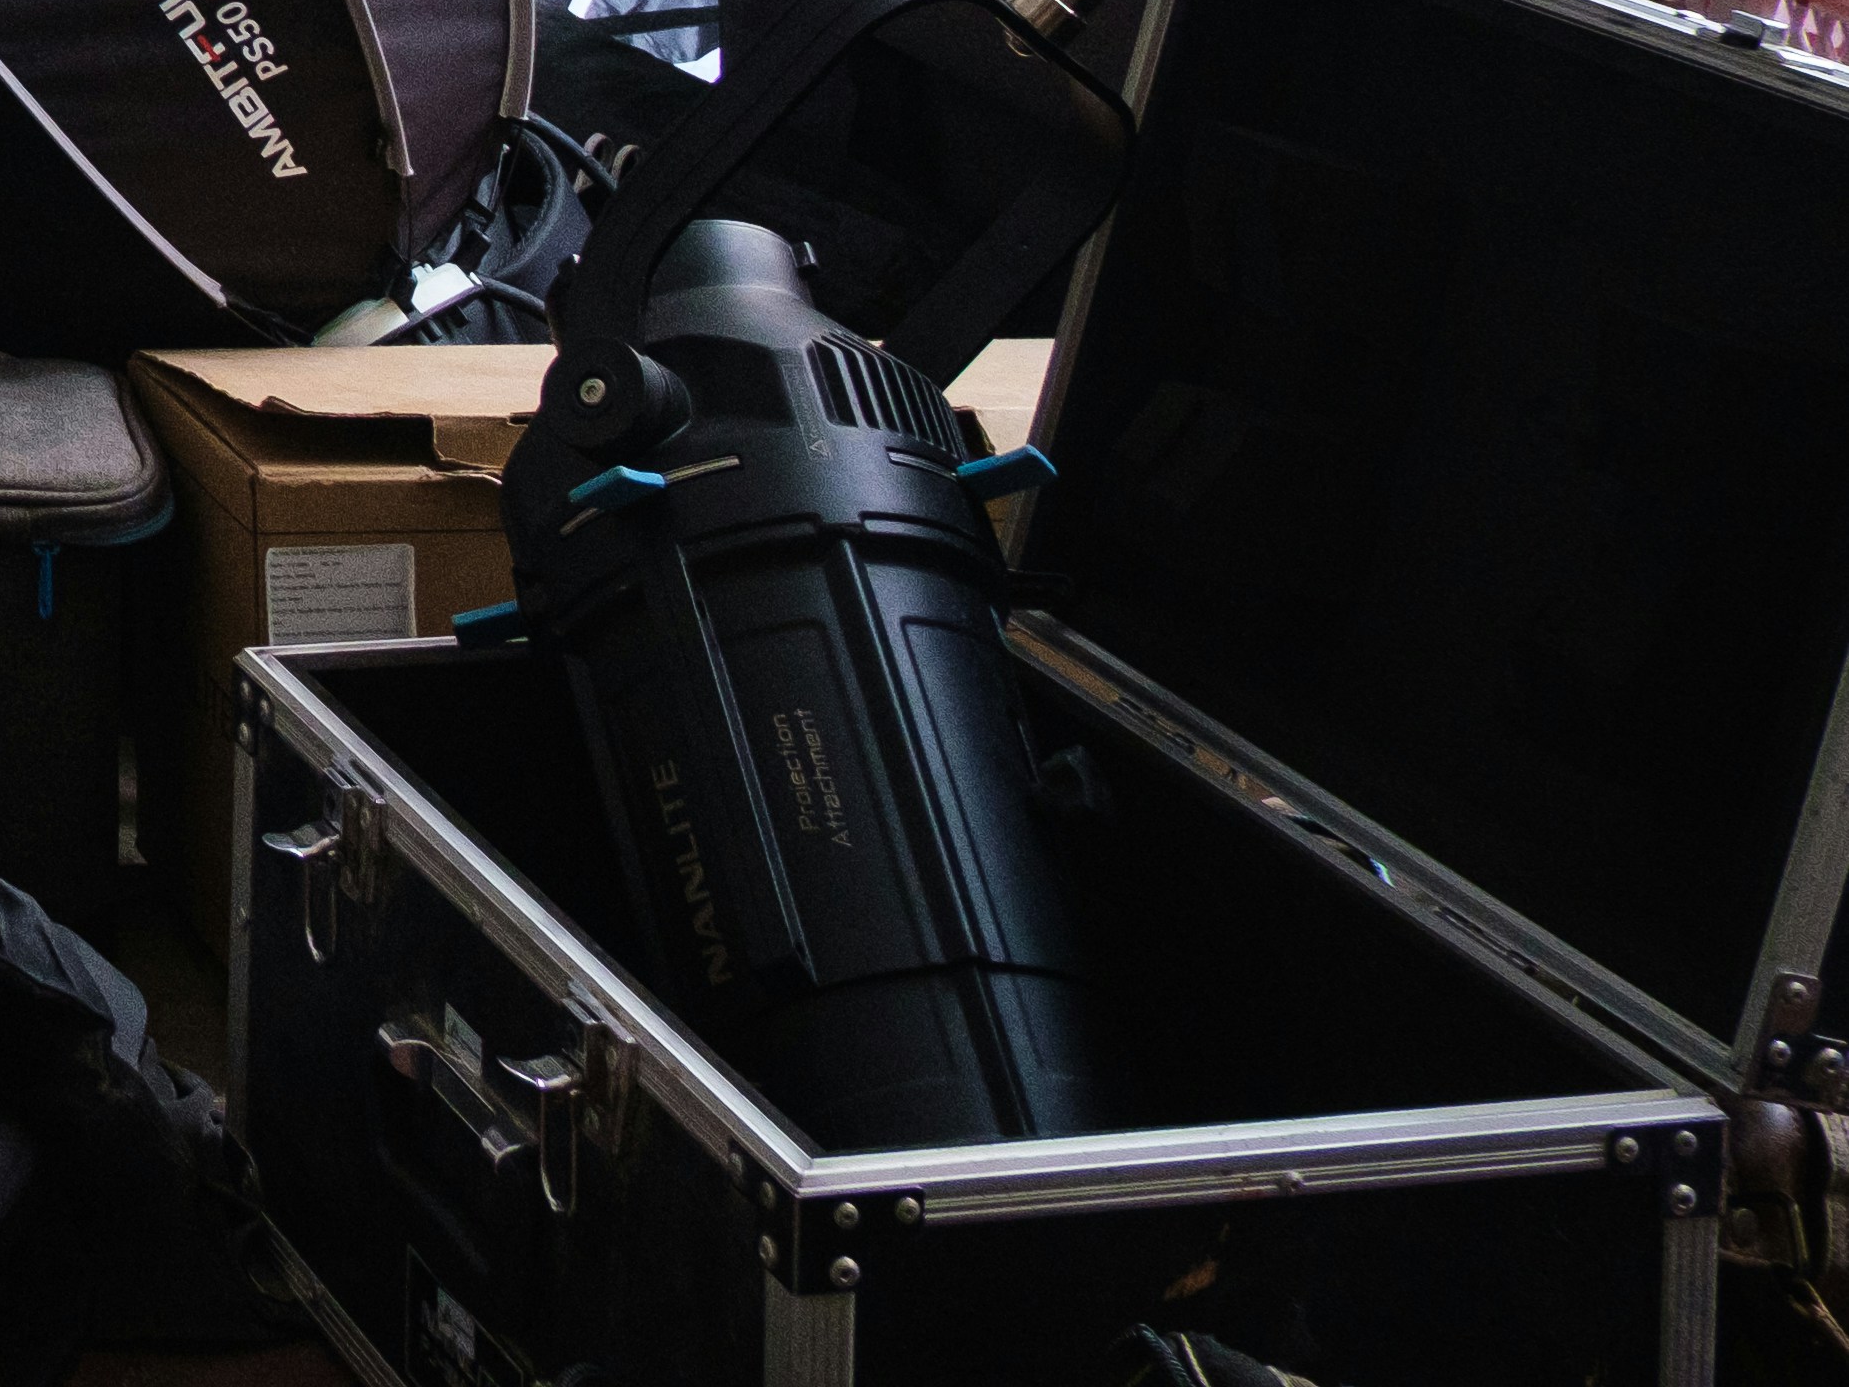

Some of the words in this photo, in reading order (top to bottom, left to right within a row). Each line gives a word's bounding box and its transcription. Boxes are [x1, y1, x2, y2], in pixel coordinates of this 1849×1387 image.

[216, 0, 290, 82] PS50
[772, 712, 818, 835] Projection
[793, 706, 854, 848] Attachment
[651, 757, 733, 988] NANLITE
